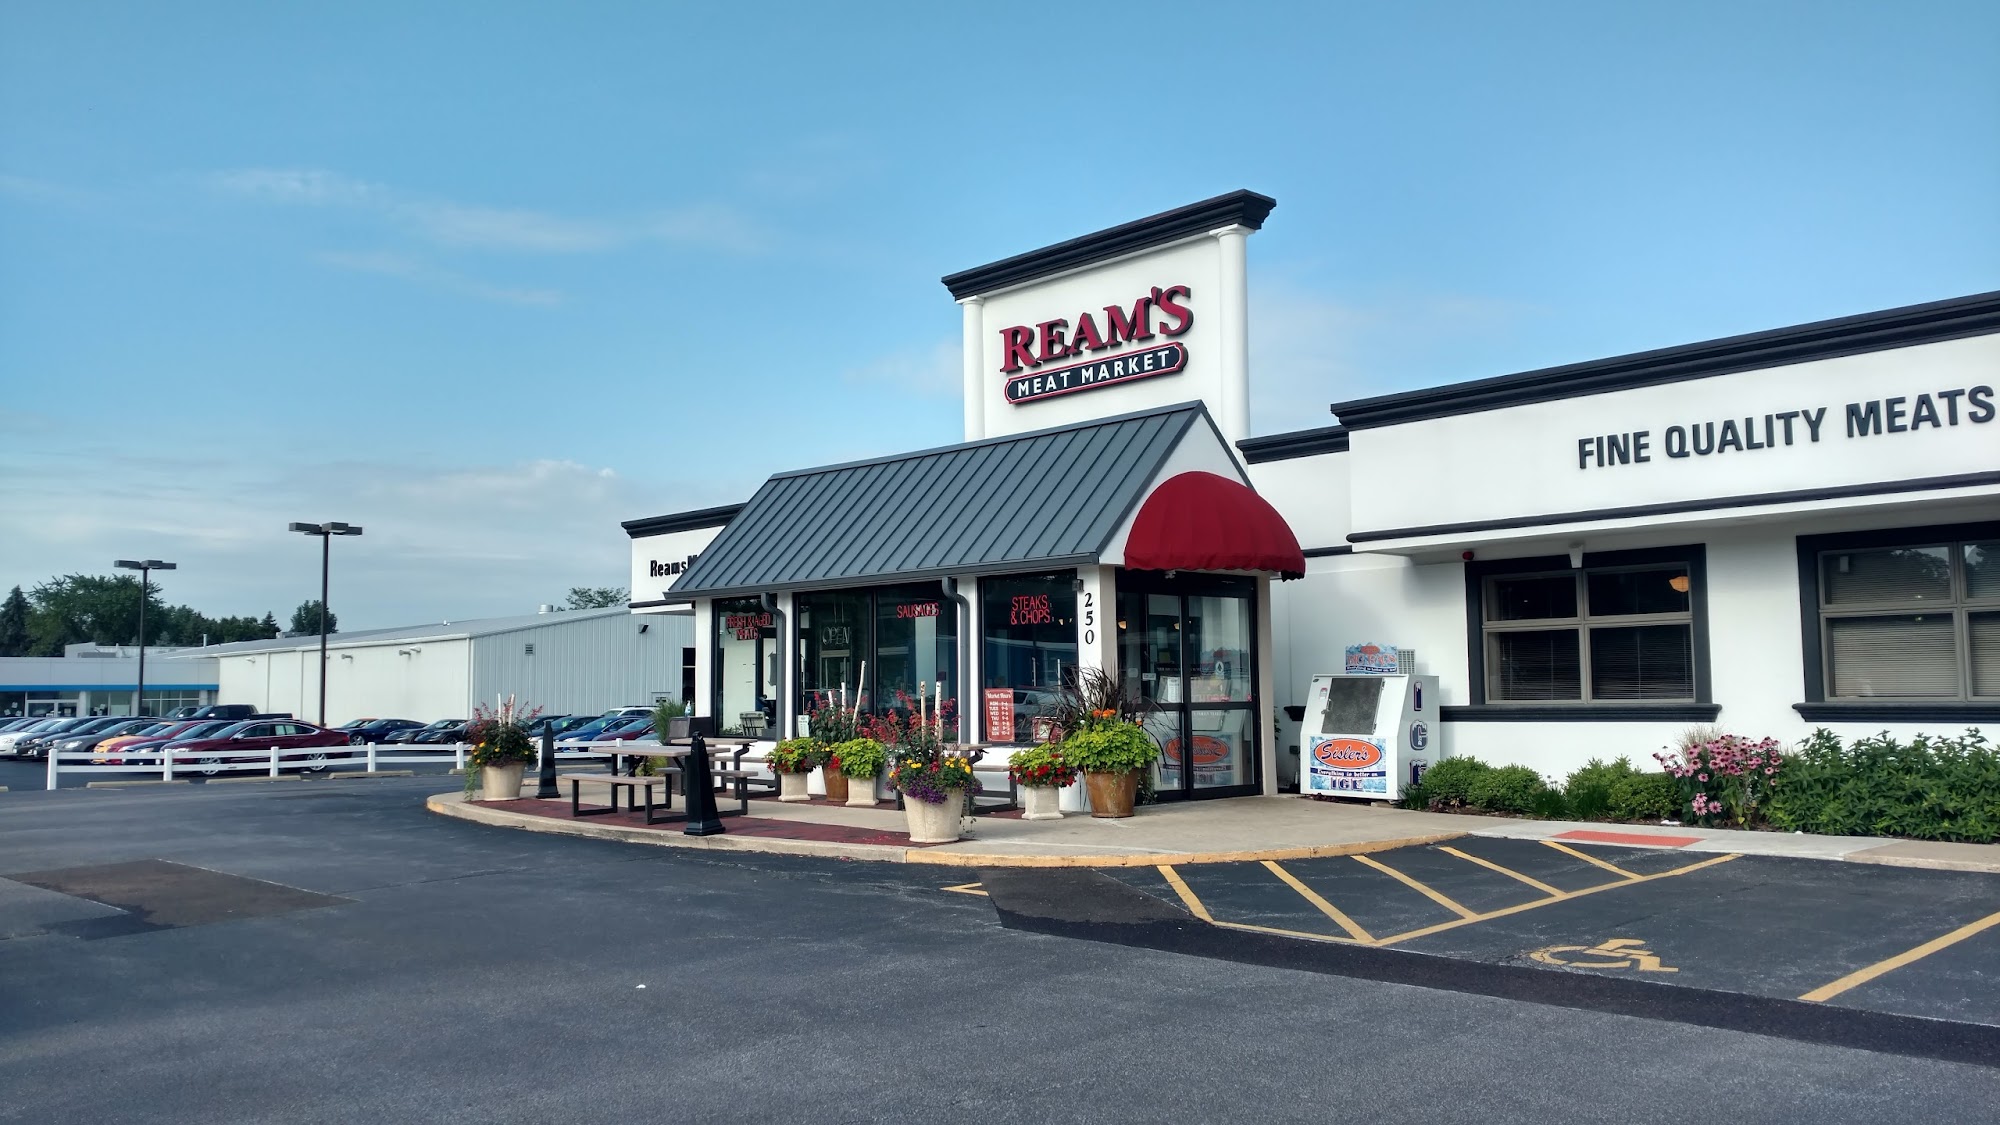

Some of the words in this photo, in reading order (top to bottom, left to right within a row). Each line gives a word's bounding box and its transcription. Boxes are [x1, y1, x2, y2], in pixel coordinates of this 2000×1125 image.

[999, 285, 1194, 373] REAM'S
[1018, 372, 1071, 397] MEAT
[1081, 350, 1170, 384] MARKET
[1578, 430, 1651, 469] FINE
[1665, 406, 1828, 458] QUALITY
[1846, 385, 1996, 438] MEATS
[896, 602, 939, 619] SAUSAGES
[1011, 594, 1048, 611] STEAKS
[1010, 611, 1018, 625] &
[1020, 609, 1051, 624] CHOPS
[1084, 592, 1095, 645] 250
[822, 625, 850, 645] OPEN
[1321, 743, 1370, 761] Sisler's
[1330, 777, 1364, 791] ICE
